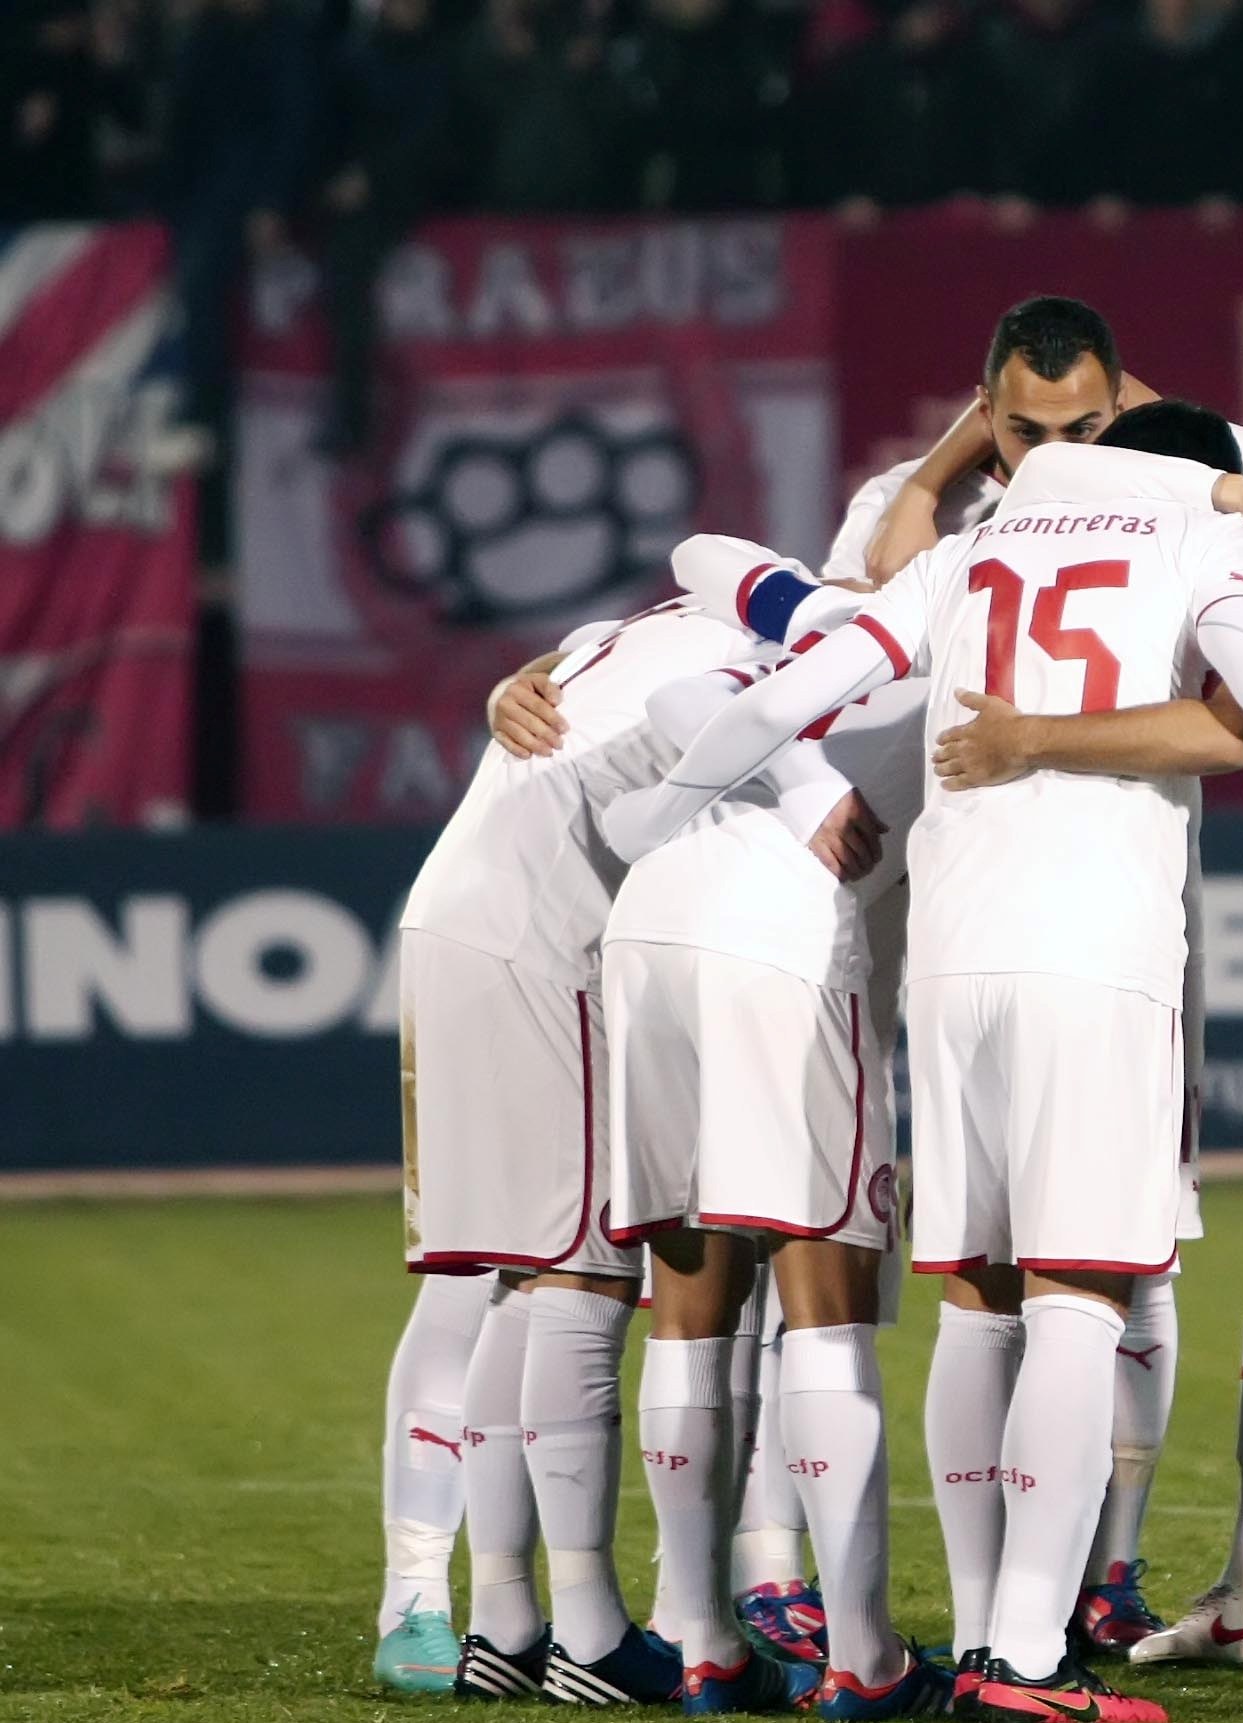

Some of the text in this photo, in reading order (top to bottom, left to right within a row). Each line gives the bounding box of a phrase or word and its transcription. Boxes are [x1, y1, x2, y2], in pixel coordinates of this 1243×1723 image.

[250, 222, 784, 338] PRAEUS
[977, 514, 1159, 543] p.contreras
[968, 557, 1131, 714] 15
[0, 886, 404, 1042] NO
[641, 1450, 689, 1471] cfp
[786, 1458, 829, 1478] cfp
[945, 1465, 997, 1484] ocf
